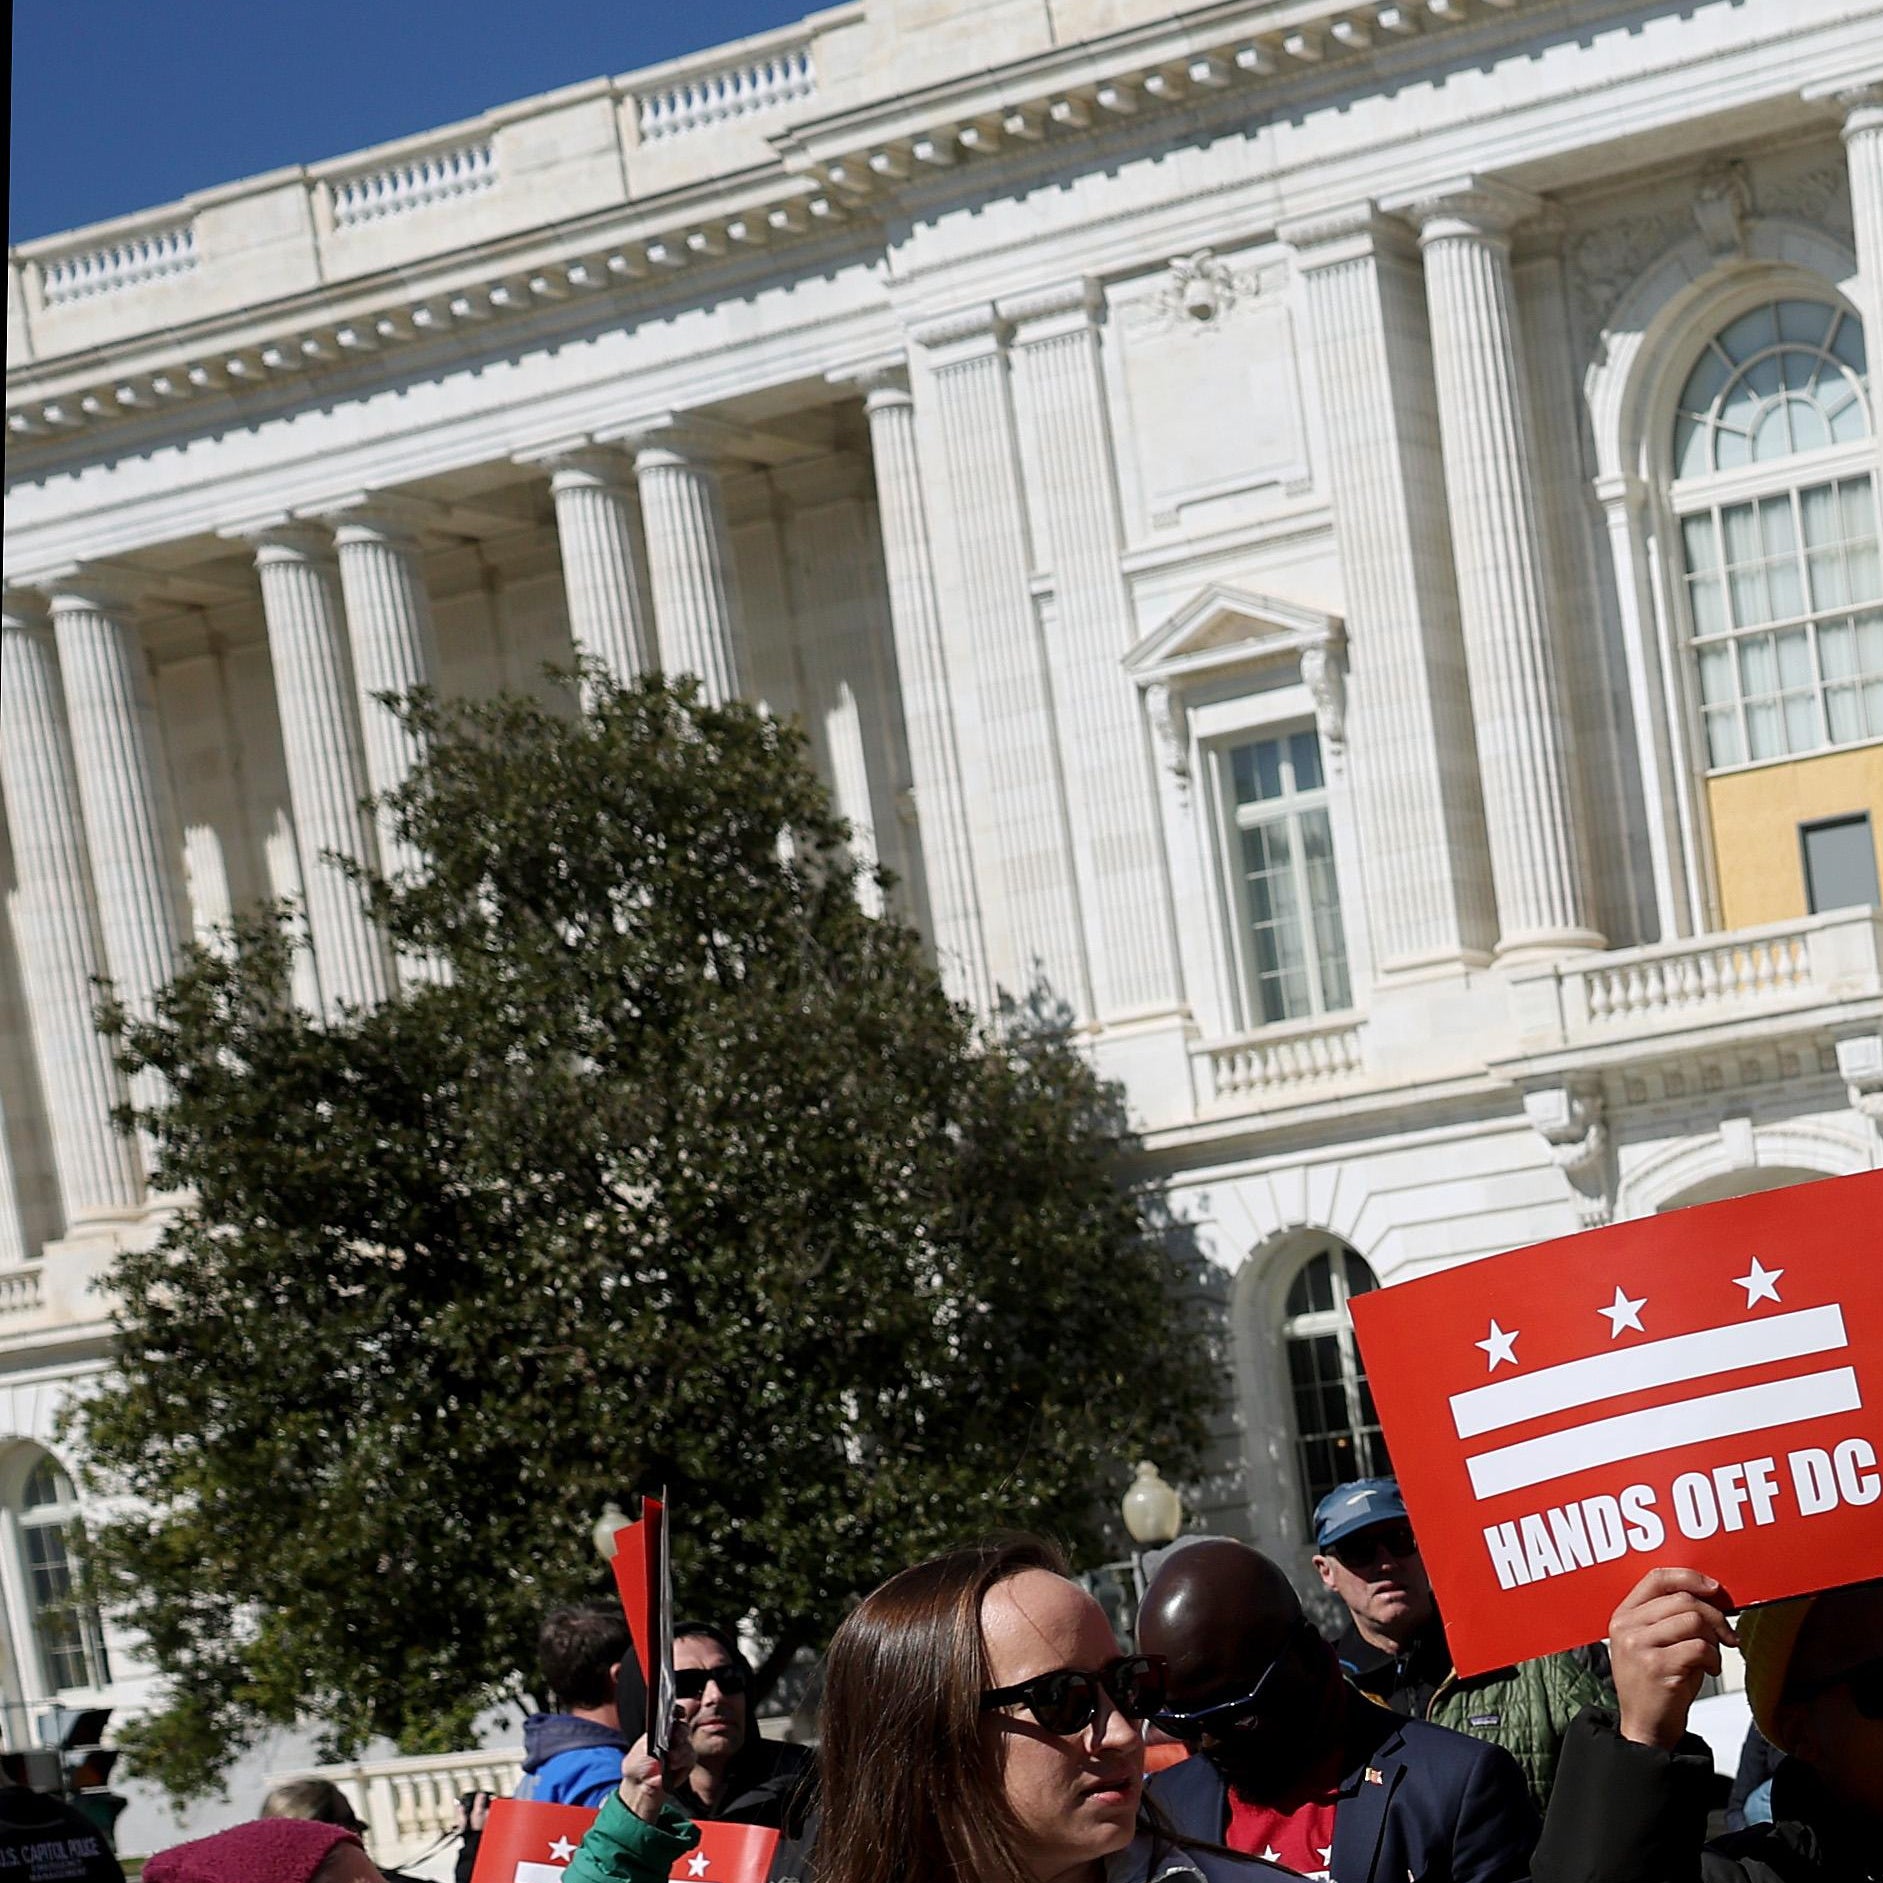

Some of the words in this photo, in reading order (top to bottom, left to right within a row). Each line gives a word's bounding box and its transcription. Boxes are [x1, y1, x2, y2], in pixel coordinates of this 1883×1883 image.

[1483, 1484, 1664, 1590] HANDS
[1672, 1457, 1779, 1540] OFF
[1788, 1438, 1881, 1517] DC
